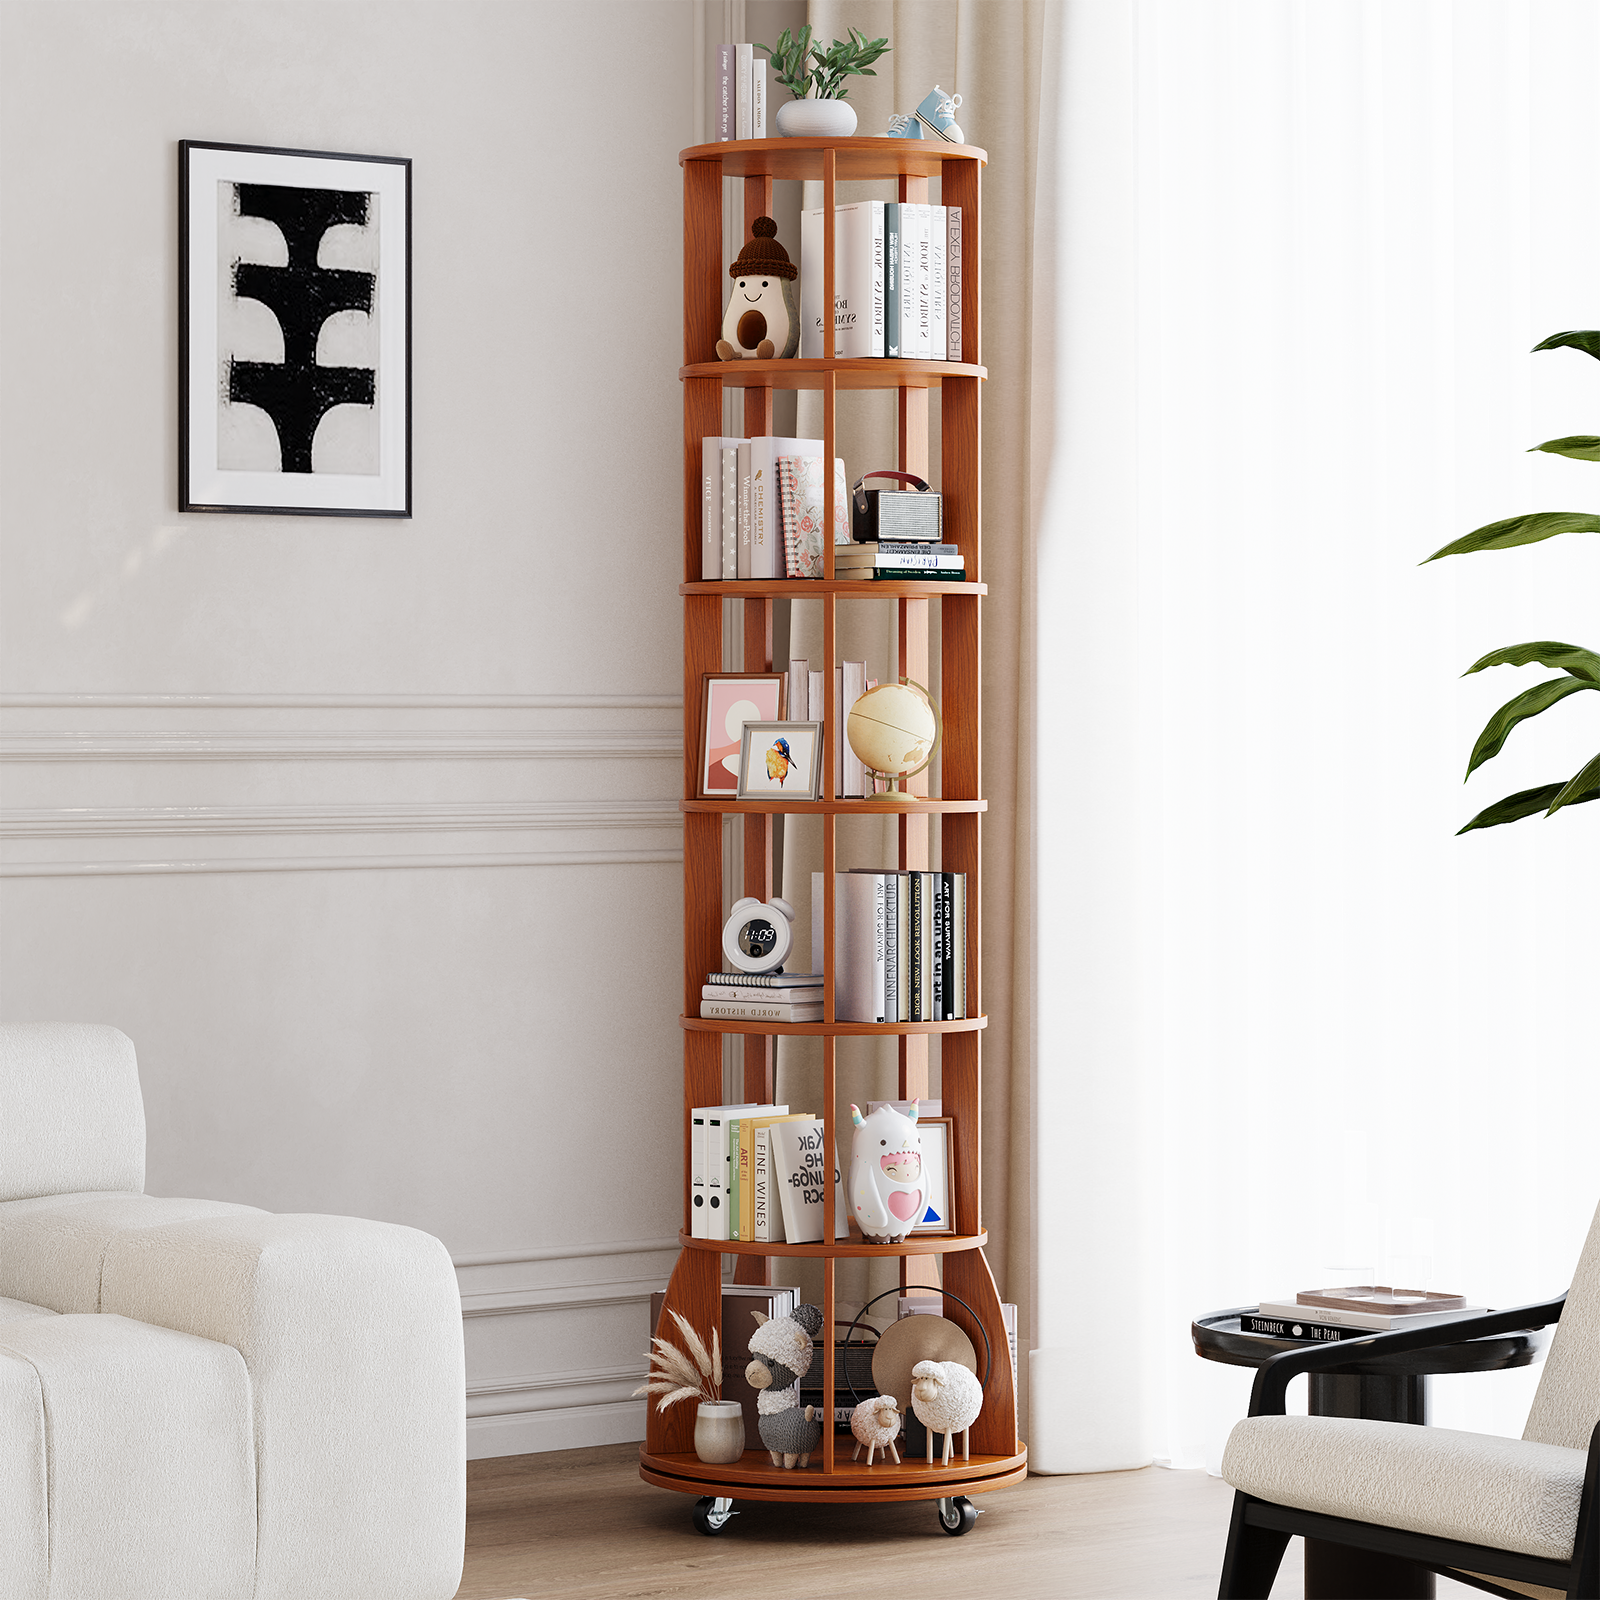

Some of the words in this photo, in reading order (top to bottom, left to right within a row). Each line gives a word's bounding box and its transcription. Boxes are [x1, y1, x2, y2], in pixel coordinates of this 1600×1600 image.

[933, 893, 942, 936] urban
[744, 929, 774, 941] 11:09
[886, 884, 896, 1000] INNENARCHITEKTUR
[934, 941, 942, 958] an
[933, 964, 942, 976] in
[933, 982, 942, 1002] art
[757, 1144, 766, 1175] FINE
[757, 1182, 766, 1227] WINES
[1251, 1318, 1284, 1334] STEINBECK
[1311, 1327, 1321, 1339] THE
